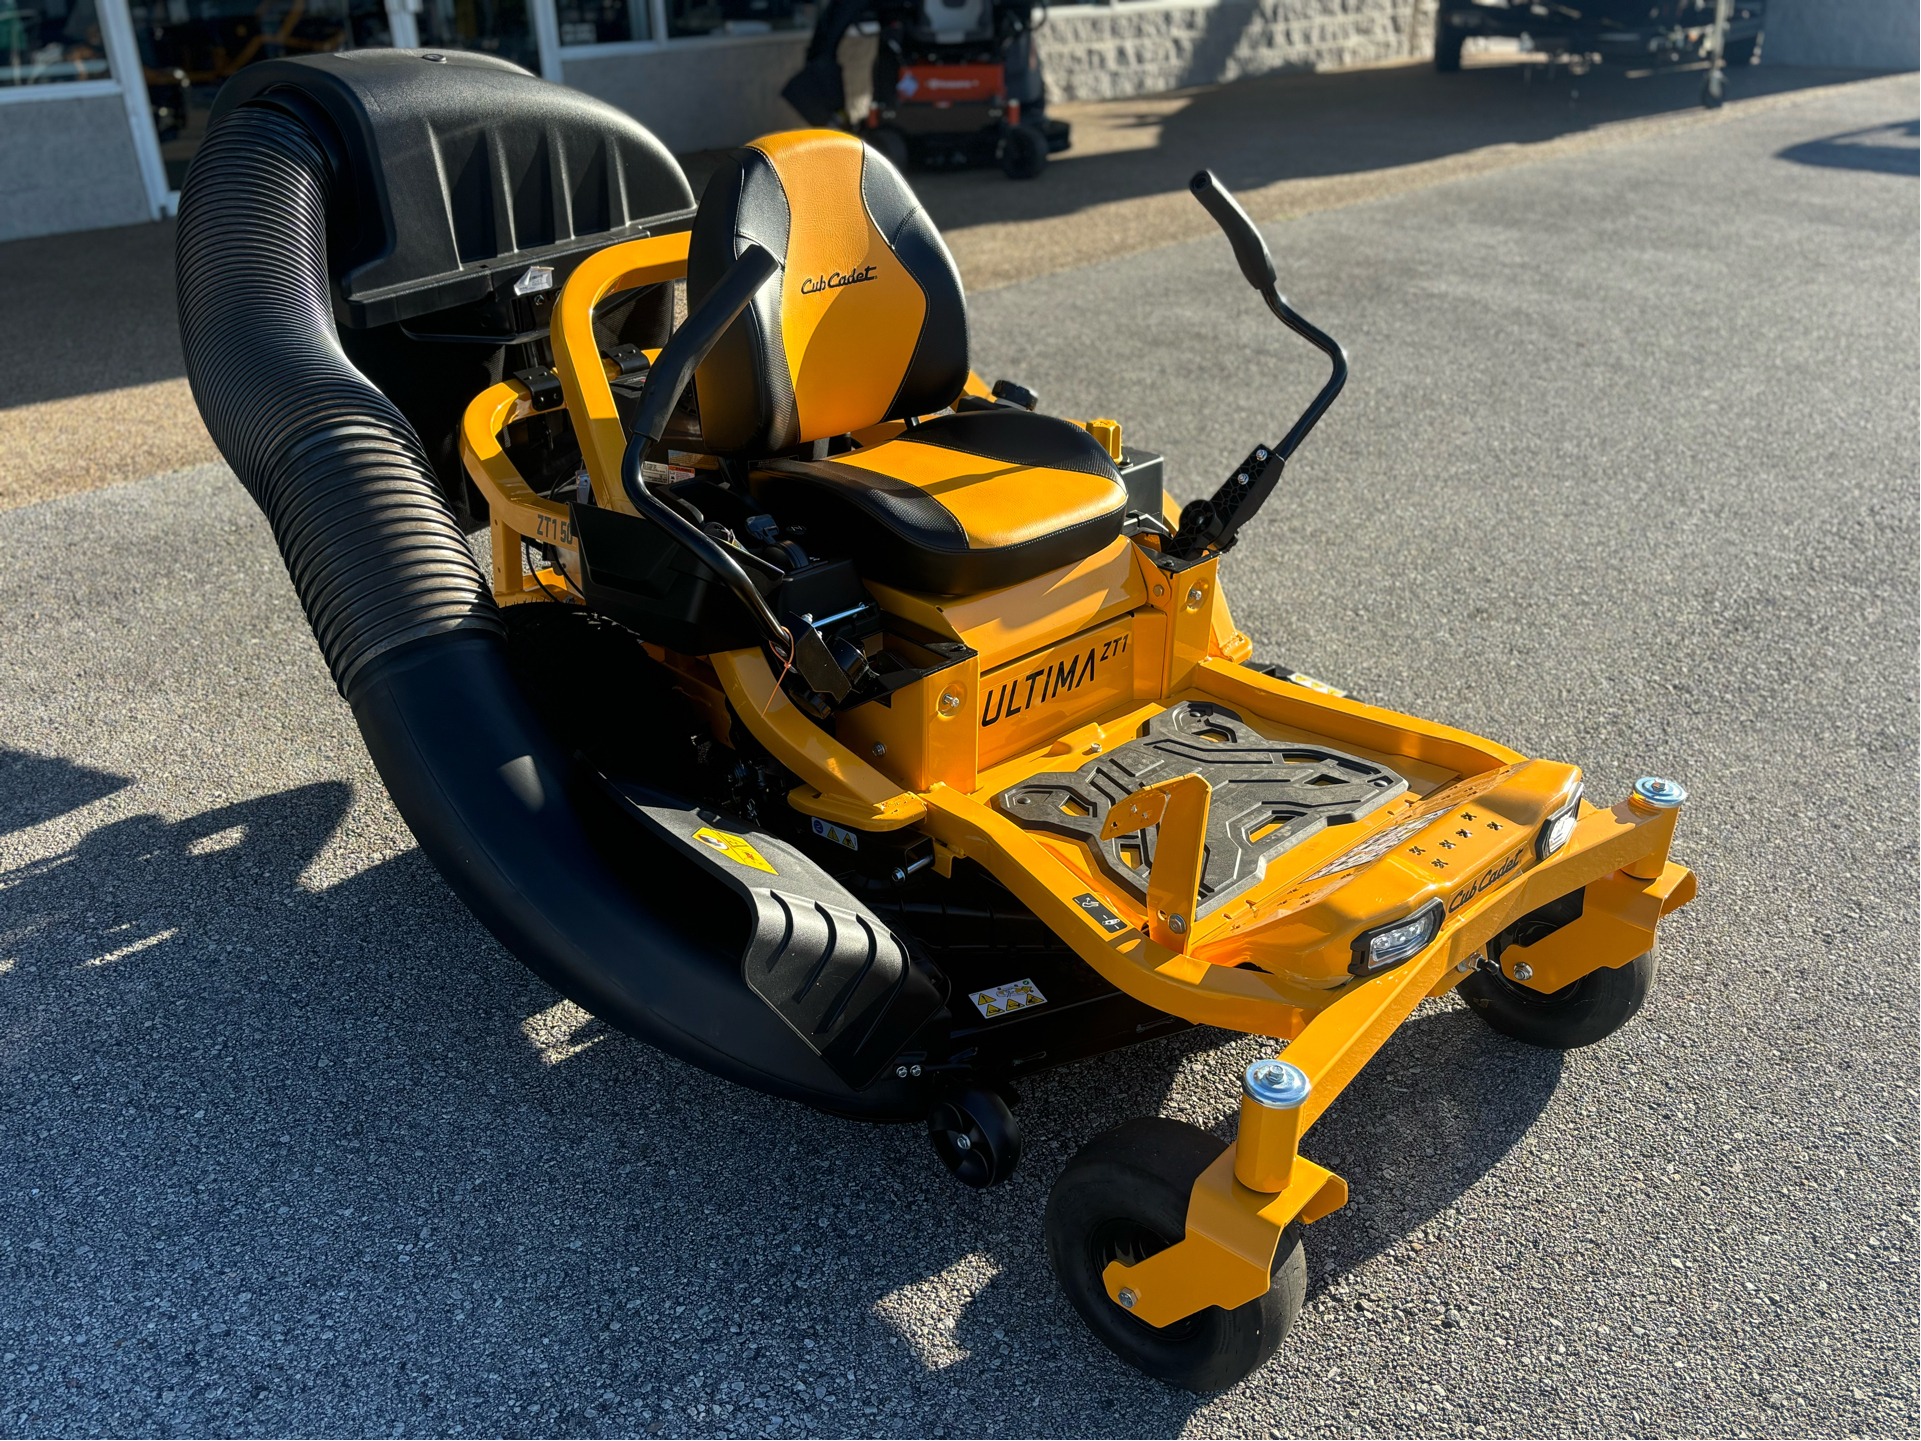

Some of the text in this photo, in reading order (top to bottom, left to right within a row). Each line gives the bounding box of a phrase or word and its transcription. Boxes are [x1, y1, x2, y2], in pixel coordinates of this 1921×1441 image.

[801, 266, 877, 295] Cub Cadet
[537, 514, 557, 540] ZT1
[981, 634, 1129, 728] ULTIMA ZT1
[1448, 848, 1524, 914] Cub Cadet
